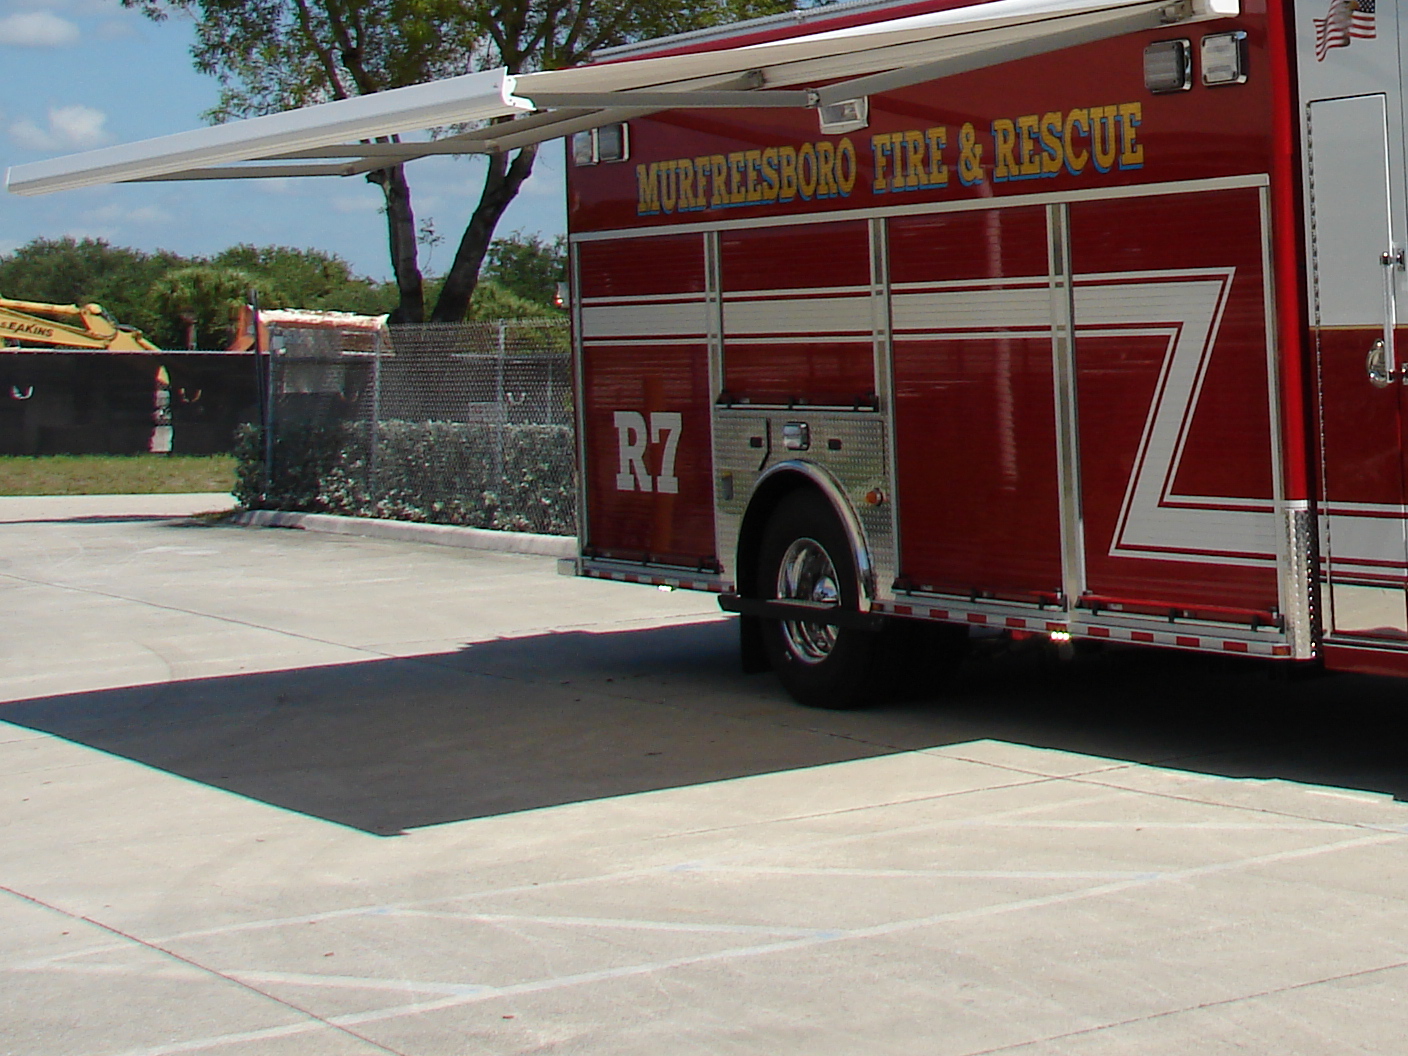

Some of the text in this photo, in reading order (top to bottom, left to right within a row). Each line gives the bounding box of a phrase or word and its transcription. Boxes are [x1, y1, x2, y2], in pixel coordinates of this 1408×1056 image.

[635, 101, 1144, 216] MURFREESBORO FIRE & RESCUE
[613, 411, 682, 493] R7
